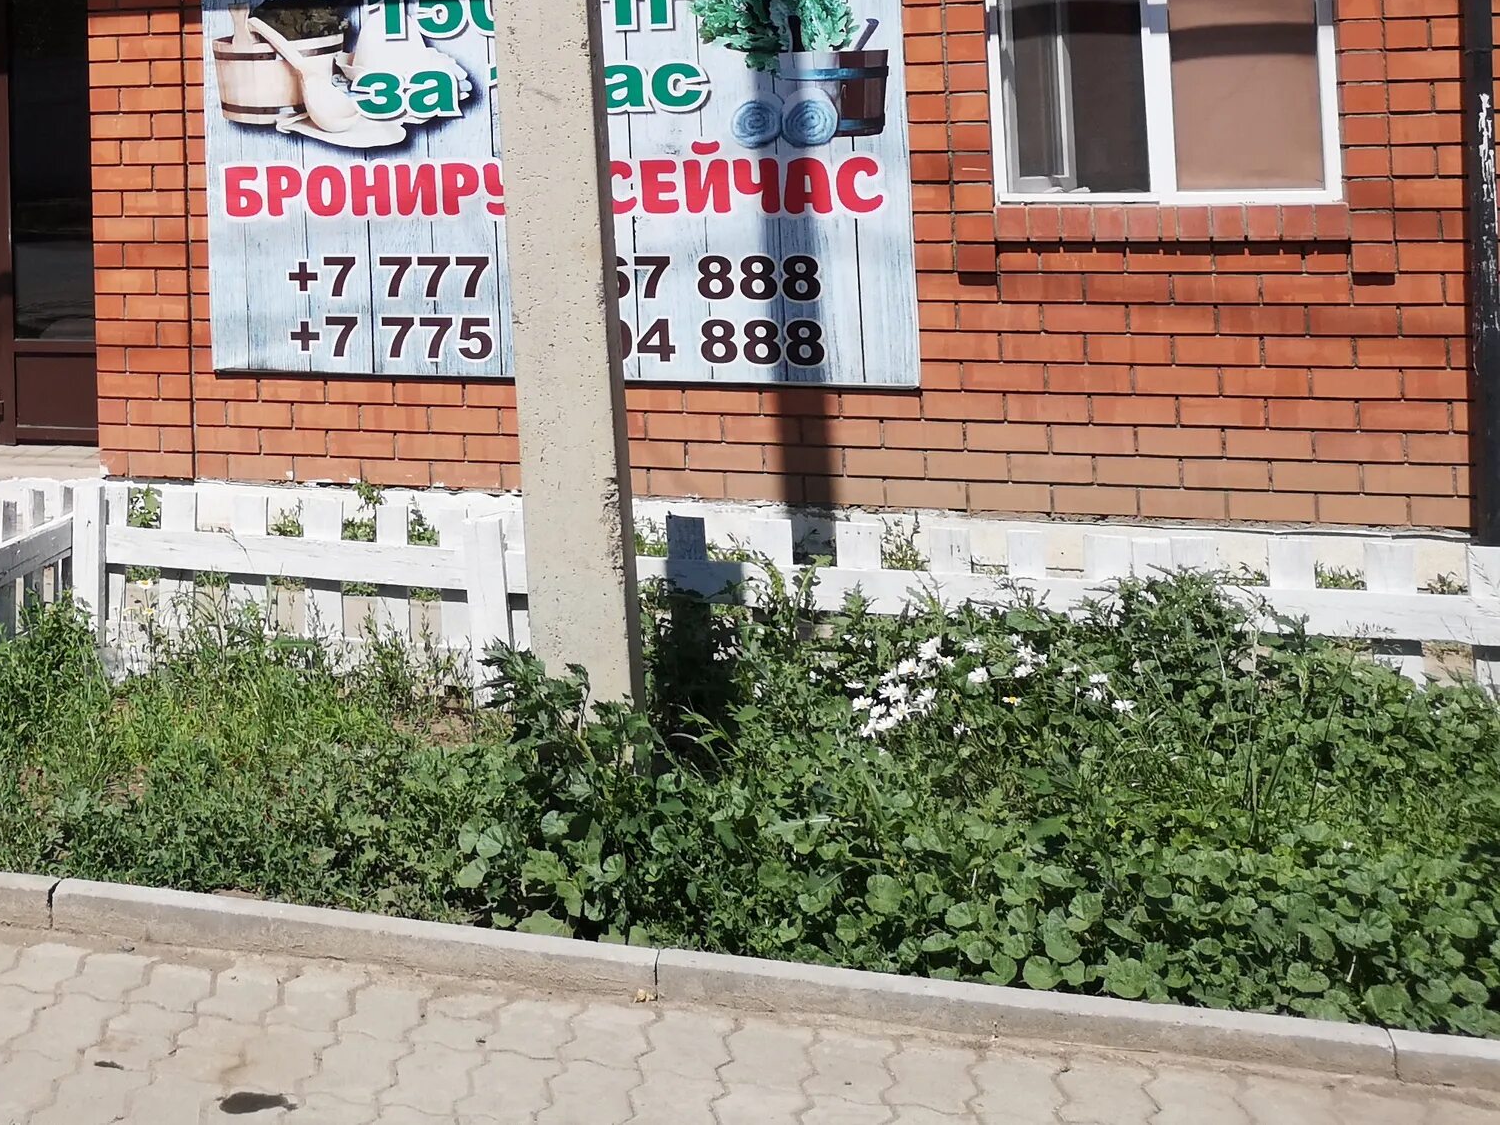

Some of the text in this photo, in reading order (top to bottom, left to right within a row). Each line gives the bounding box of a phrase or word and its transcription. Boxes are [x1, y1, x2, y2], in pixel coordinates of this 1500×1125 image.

[354, 62, 702, 115] за ас
[610, 140, 884, 215] СЕЙЧАС
[288, 256, 357, 299] +7
[378, 256, 490, 299] 777
[697, 255, 822, 301] 888
[290, 316, 359, 358] +7
[381, 316, 493, 360] 775
[700, 319, 826, 366] 888
